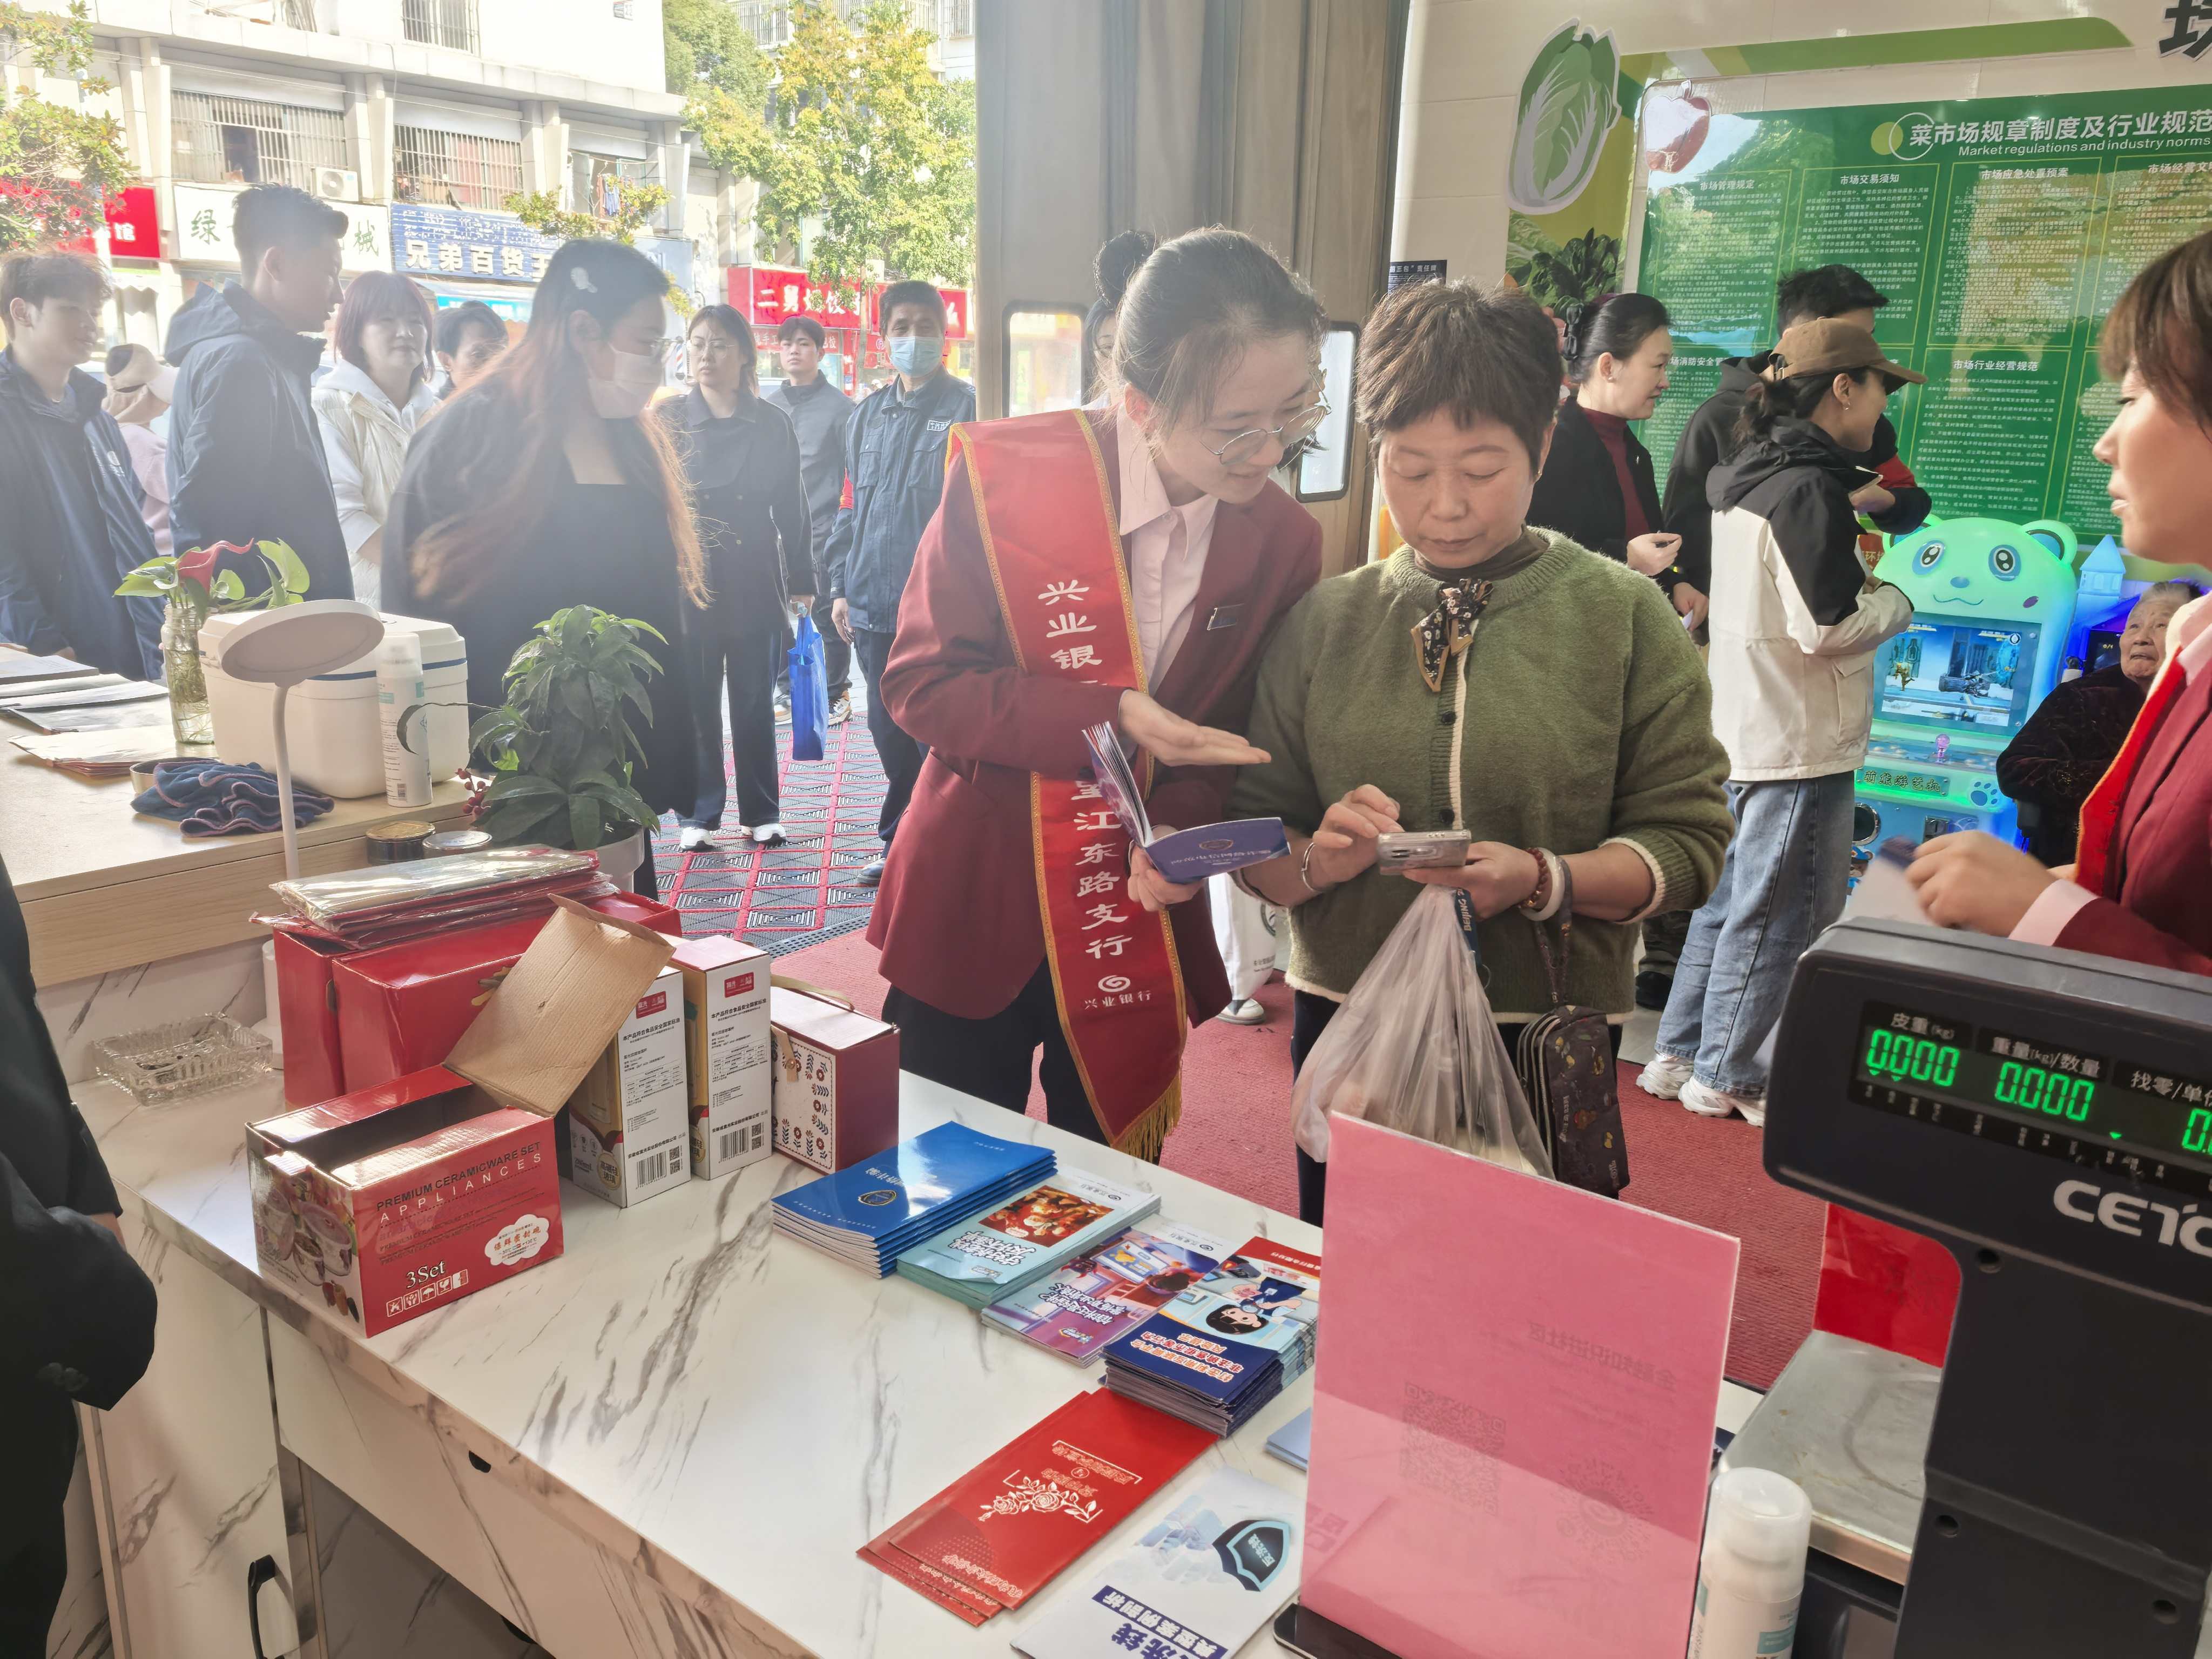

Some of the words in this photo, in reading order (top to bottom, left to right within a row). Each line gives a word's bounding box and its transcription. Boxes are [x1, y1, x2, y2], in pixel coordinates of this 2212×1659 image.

[1910, 109, 2212, 147] 菜市场规章制度及行业规范
[1959, 146, 2001, 156] Market
[2004, 143, 2077, 156] regulations
[2080, 141, 2105, 151] and
[2107, 138, 2162, 151] industry
[2166, 136, 2210, 146] norms
[1700, 180, 1755, 191] 市场管理规定
[1840, 173, 1899, 185] 市场交易须知
[1981, 167, 2069, 180] 市场应急处置预案
[191, 210, 221, 246] 绿
[354, 219, 379, 257] 械
[1669, 356, 1729, 367] 场消防安全管
[1953, 360, 2039, 372] 市场行业经营规范
[1038, 579, 1108, 686] 兴业银
[1864, 770, 1941, 792] 萌熊游艺机
[1084, 990, 1151, 1010] 兴业银行
[1994, 1061, 2095, 1122] 0.000
[2181, 1108, 2212, 1155] 0.
[377, 1183, 433, 1211] PREMIUM
[435, 1149, 518, 1189] CERAMICWARE
[520, 1141, 541, 1156] SET
[380, 1153, 541, 1223] APPLIANCES
[1130, 1339, 1234, 1382] 打击利用互联网平台
[1141, 1331, 1244, 1374] 非法销售假币等行为
[1176, 1332, 1228, 1353] 风险提示
[941, 1554, 1023, 1599] 我为群众办实事
[1102, 1590, 1218, 1658] 典型案例剖析
[1111, 1622, 1203, 1659] 洗钱
